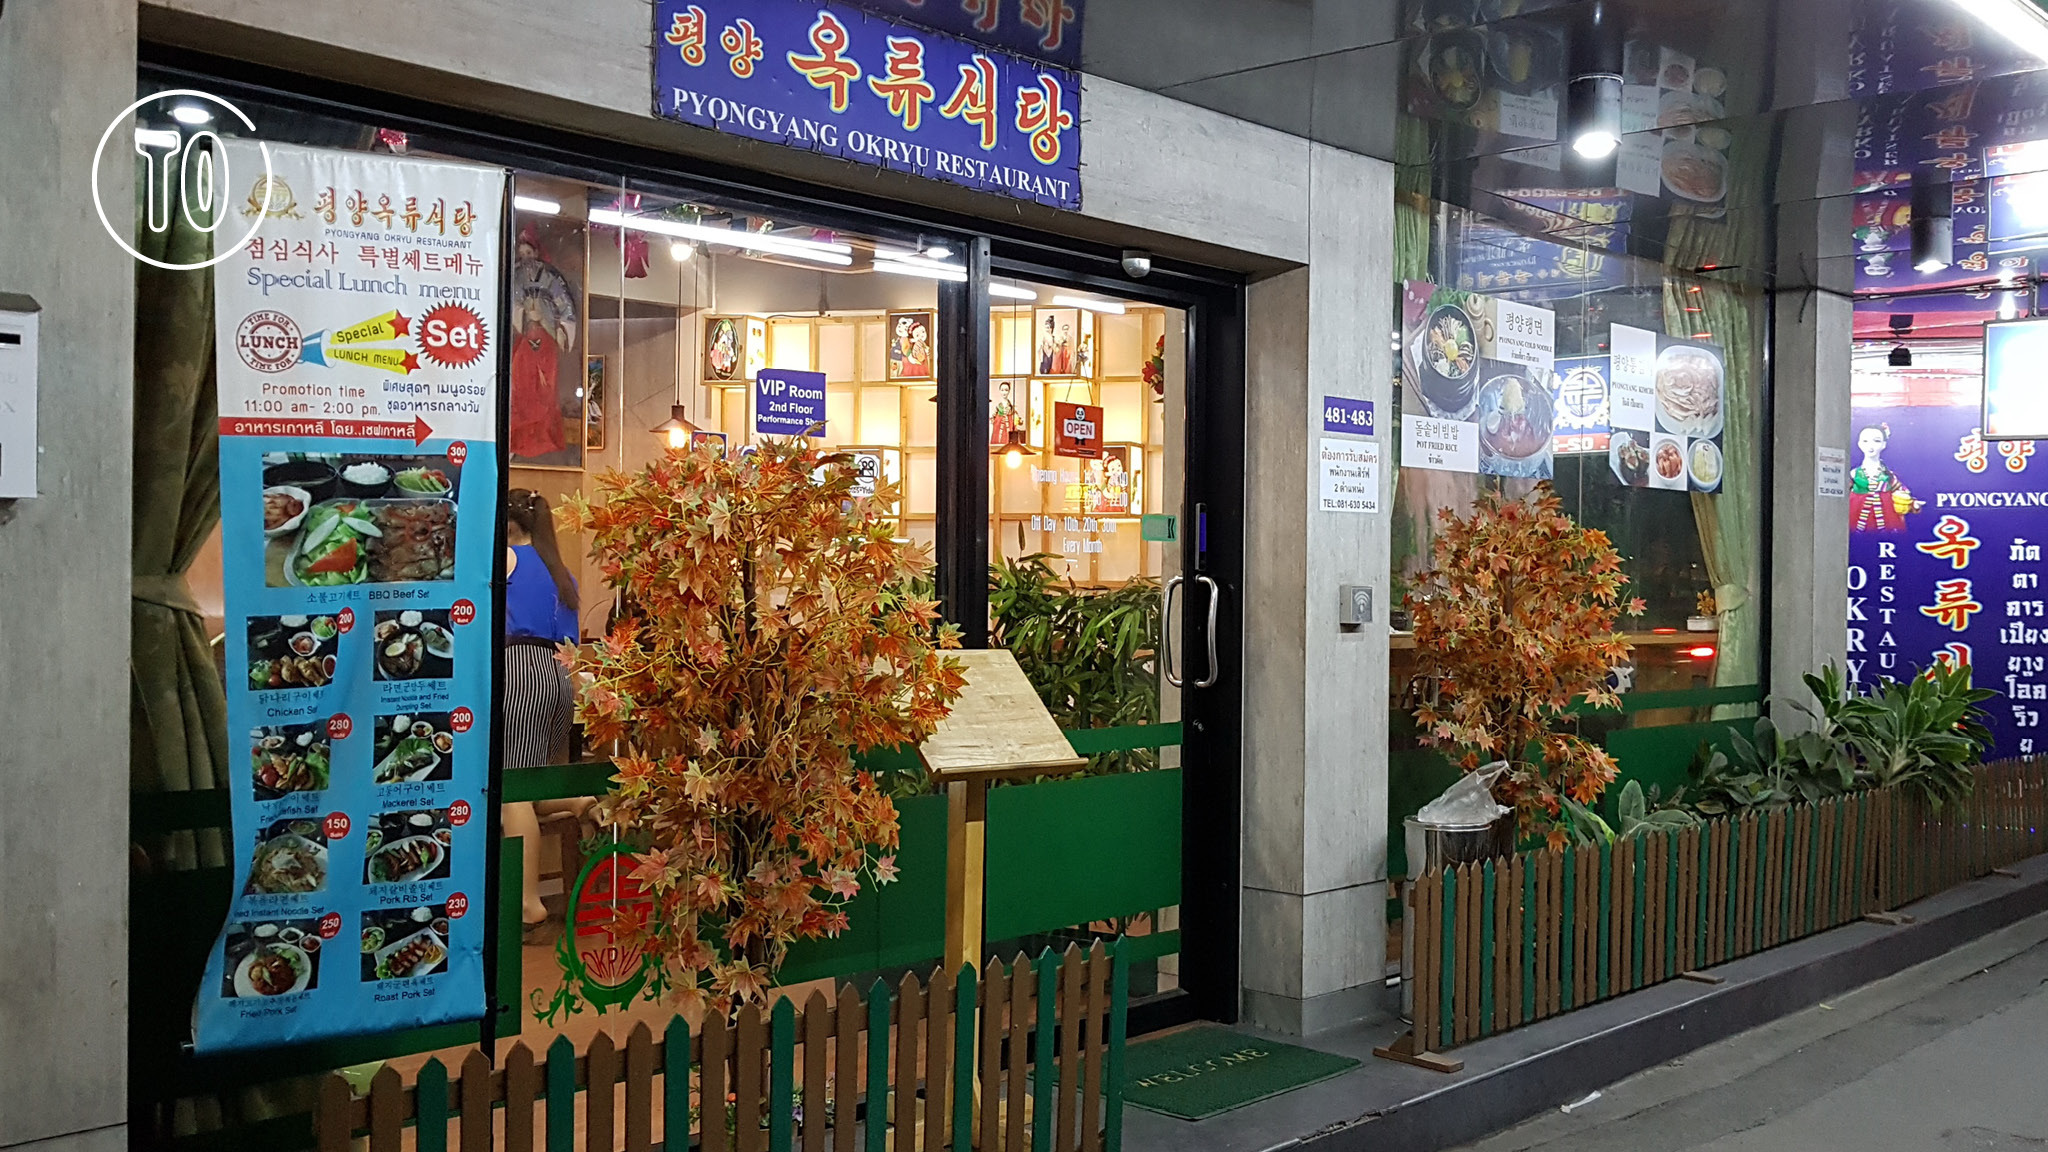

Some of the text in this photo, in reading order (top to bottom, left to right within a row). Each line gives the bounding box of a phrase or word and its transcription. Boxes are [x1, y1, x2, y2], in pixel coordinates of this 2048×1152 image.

[787, 10, 1073, 166] 옥류식당
[672, 87, 1070, 201] PYONGYANG OKRYU RESTAURANT
[325, 228, 472, 249] PYONGYANG OKRYU RESTAURANT
[245, 236, 339, 264] 점심식사
[247, 267, 481, 302] Special Lunch menu
[247, 313, 290, 328] TIME FOR
[336, 322, 384, 345] Special
[426, 319, 479, 349] Set
[240, 335, 299, 349] LUNCH
[250, 357, 292, 370] TIME FOR
[333, 349, 400, 367] LUNCH MENU
[262, 382, 365, 398] Promotion time
[437, 379, 486, 397] เมนูอร่อย
[759, 378, 823, 400] VIP Room
[244, 400, 283, 412] 11:00
[323, 401, 354, 414] 2:00
[387, 400, 480, 414] ชุดอาหารกลางวัน
[769, 401, 815, 414] 2nd Floor
[757, 414, 804, 426] Performance
[1325, 406, 1373, 427] 481-483
[234, 421, 324, 434] อาหารเกาหลี
[1066, 422, 1093, 436] OPEN
[449, 447, 466, 457] 300
[1416, 440, 1427, 449] POT
[1445, 443, 1458, 452] RICE
[1044, 516, 1056, 533] Day
[368, 590, 390, 600] BBQ
[392, 589, 415, 599] Beef
[453, 606, 473, 616] 200
[267, 707, 304, 717] Chicken
[452, 712, 471, 723] 200
[329, 718, 350, 731] 280
[382, 797, 434, 808] Mackerel Set
[450, 806, 468, 817] 280
[326, 818, 348, 829] 150
[380, 893, 433, 905] Pork Rib Set
[448, 898, 466, 909] 230
[321, 917, 340, 930] 250
[374, 993, 399, 1002] Roast
[401, 991, 421, 999] Pork
